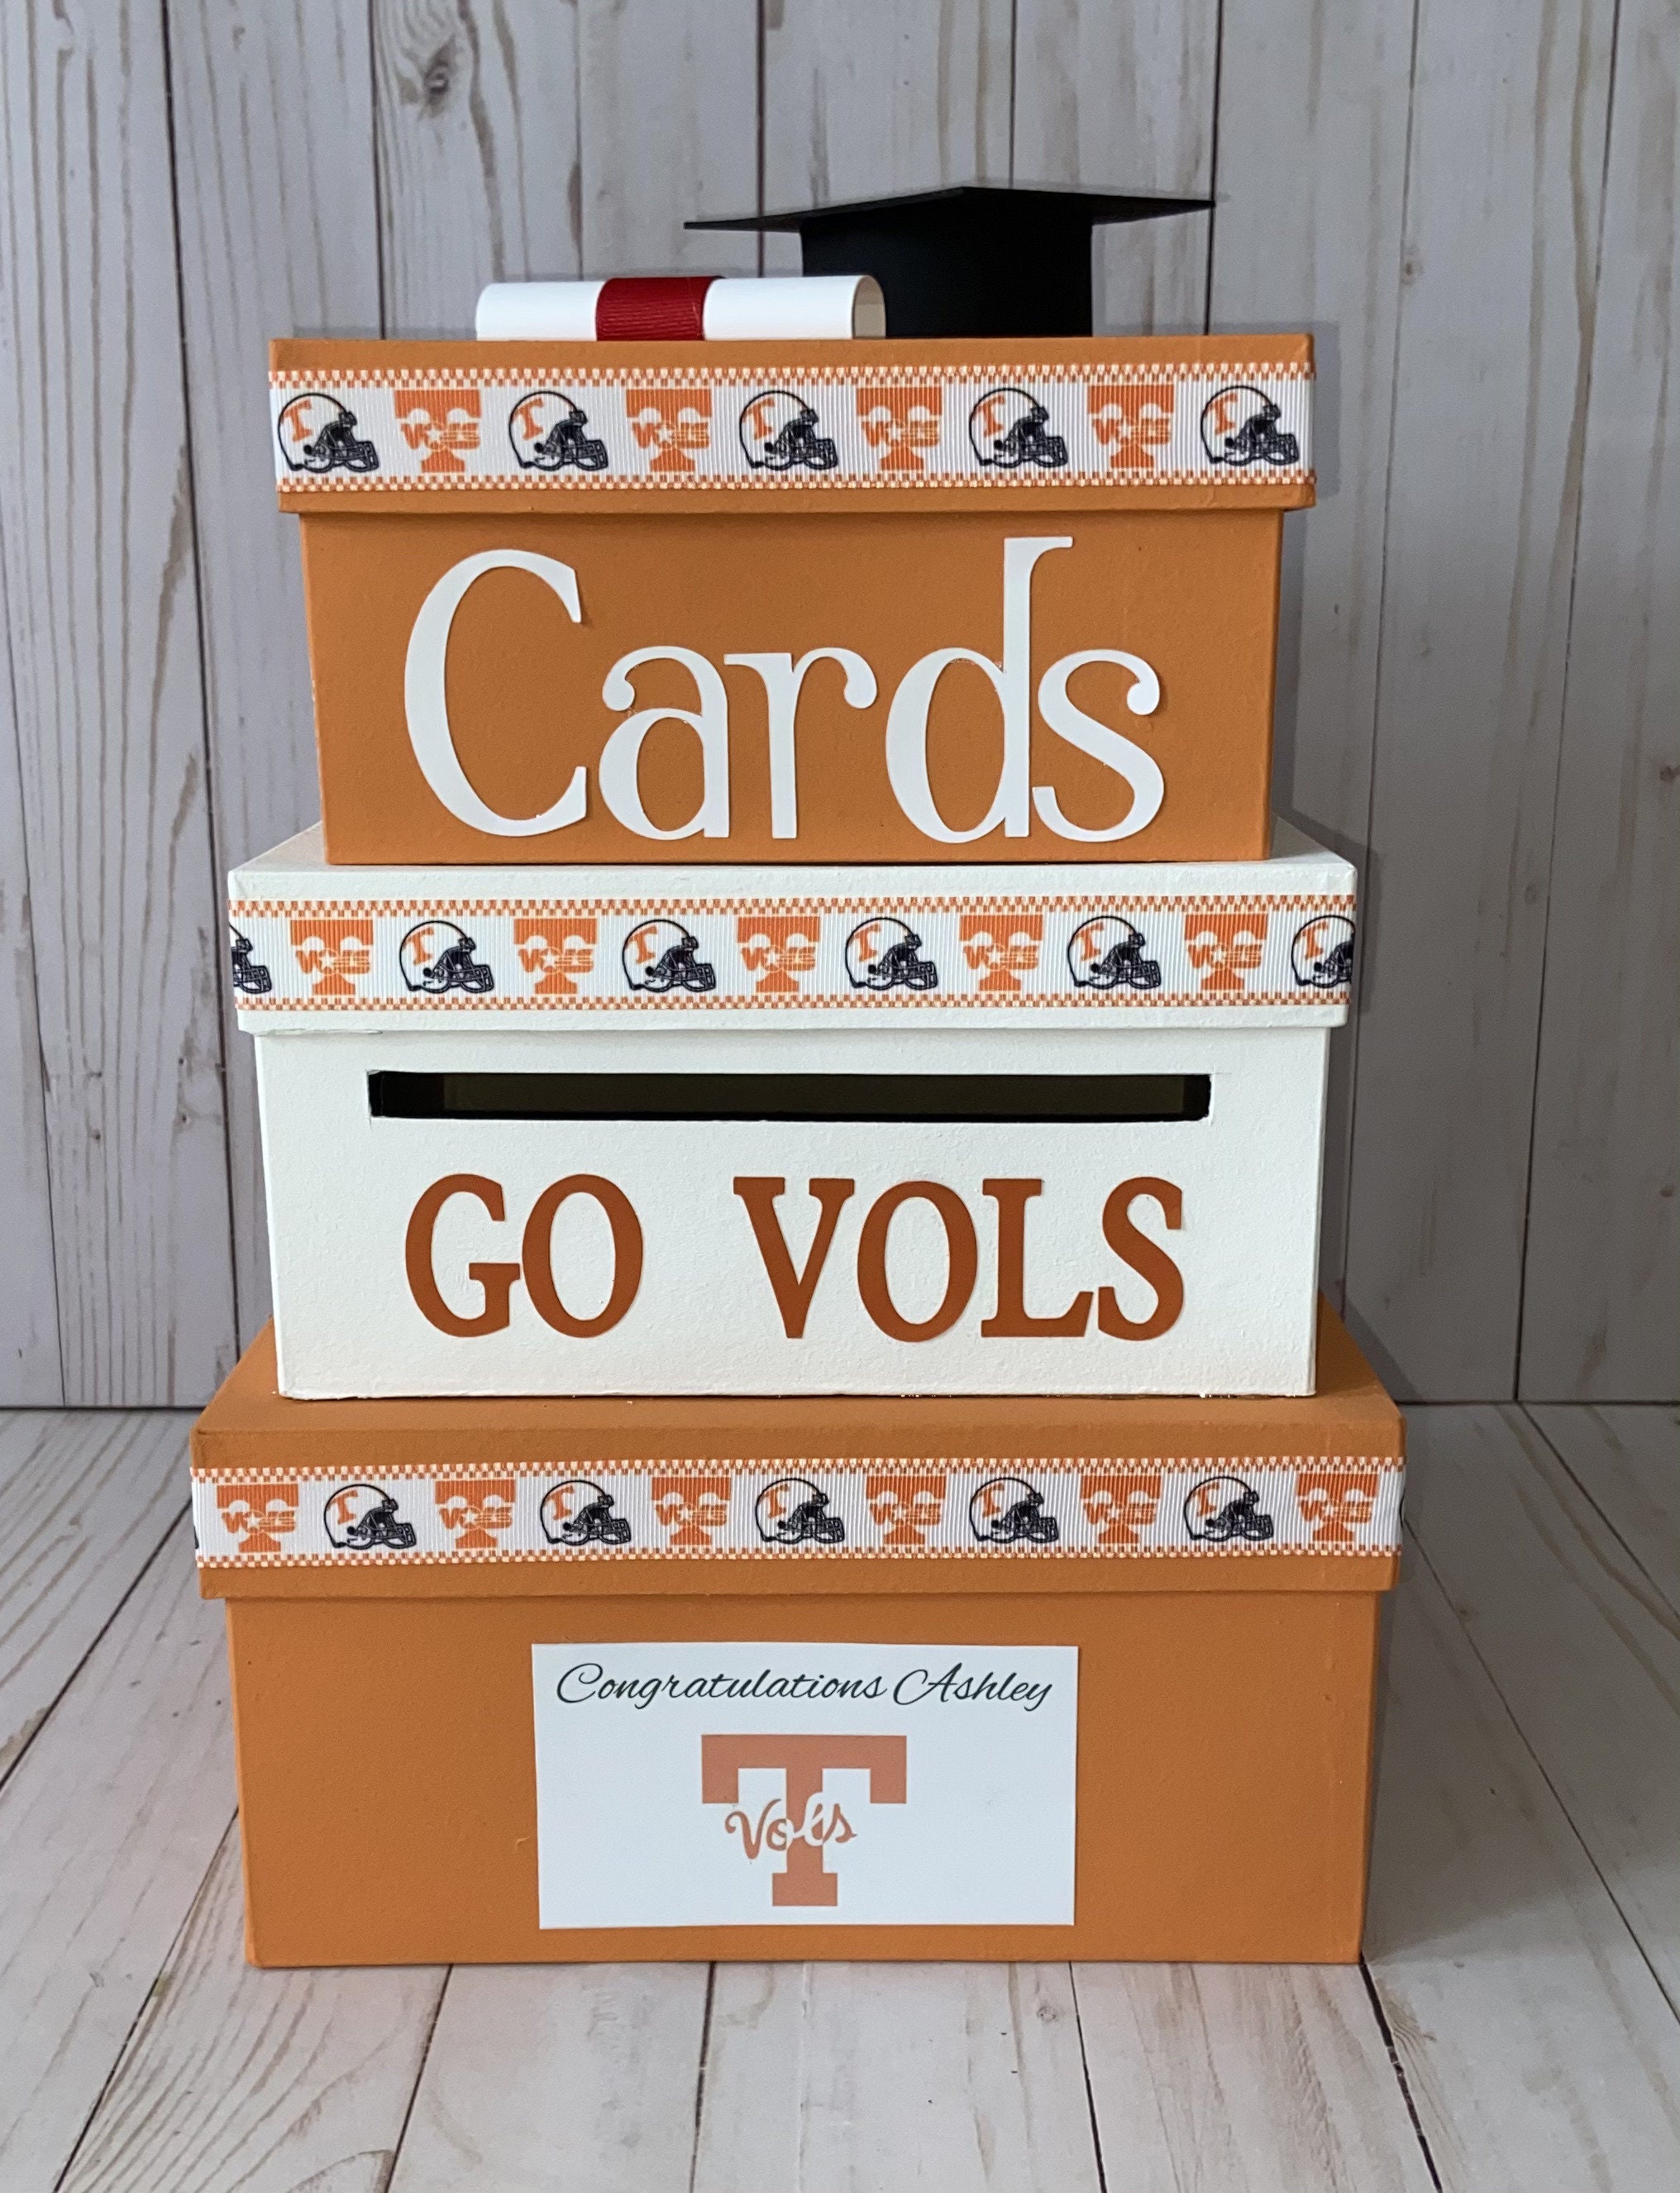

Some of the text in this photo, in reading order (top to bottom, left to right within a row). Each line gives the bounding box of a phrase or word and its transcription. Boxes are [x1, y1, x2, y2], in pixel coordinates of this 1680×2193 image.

[284, 399, 313, 442] T
[394, 389, 480, 472] T
[514, 397, 545, 440] T
[626, 389, 712, 471] T
[745, 398, 776, 440] T
[856, 387, 943, 471] T
[972, 394, 1005, 437] T
[1087, 385, 1174, 467] T
[1205, 393, 1238, 435] T
[404, 537, 1164, 843] Cards
[290, 920, 373, 995] T
[403, 927, 434, 964] T
[513, 918, 597, 994] T
[628, 926, 657, 964] T
[737, 916, 820, 992] T
[851, 924, 881, 963] T
[959, 915, 1043, 991] T
[1076, 923, 1105, 961] T
[1184, 913, 1268, 991] T
[1299, 921, 1329, 960] T
[405, 1173, 1184, 1342] GO VOLS
[217, 1484, 298, 1553] T
[331, 1490, 358, 1525] T
[435, 1479, 516, 1549] T
[546, 1486, 575, 1520] T
[651, 1477, 732, 1546] T
[761, 1484, 790, 1518] T
[866, 1475, 947, 1545] T
[976, 1482, 1005, 1517] T
[1081, 1475, 1162, 1544] T
[1194, 1483, 1219, 1517] T
[1296, 1474, 1379, 1541] T
[556, 1662, 1053, 1712] Congratulations Ashley
[701, 1735, 907, 1907] T
